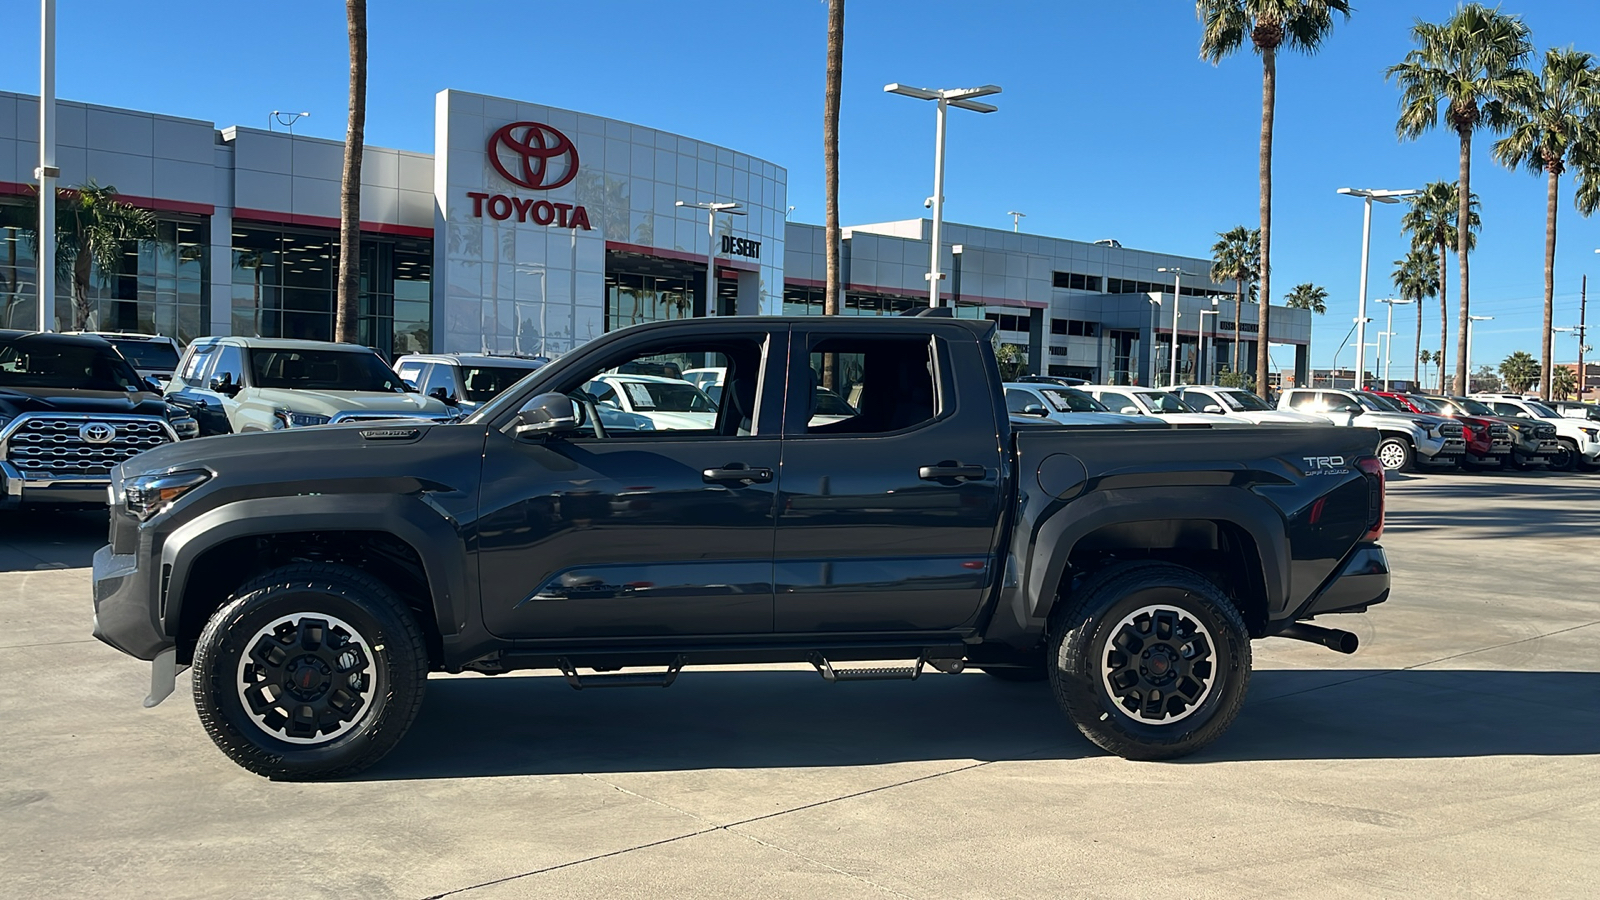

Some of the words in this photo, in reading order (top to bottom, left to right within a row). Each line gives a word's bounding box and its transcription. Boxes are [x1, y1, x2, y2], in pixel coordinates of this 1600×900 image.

[466, 192, 592, 231] TOYOTA
[721, 235, 762, 259] DESERT
[1303, 456, 1345, 469] TRD
